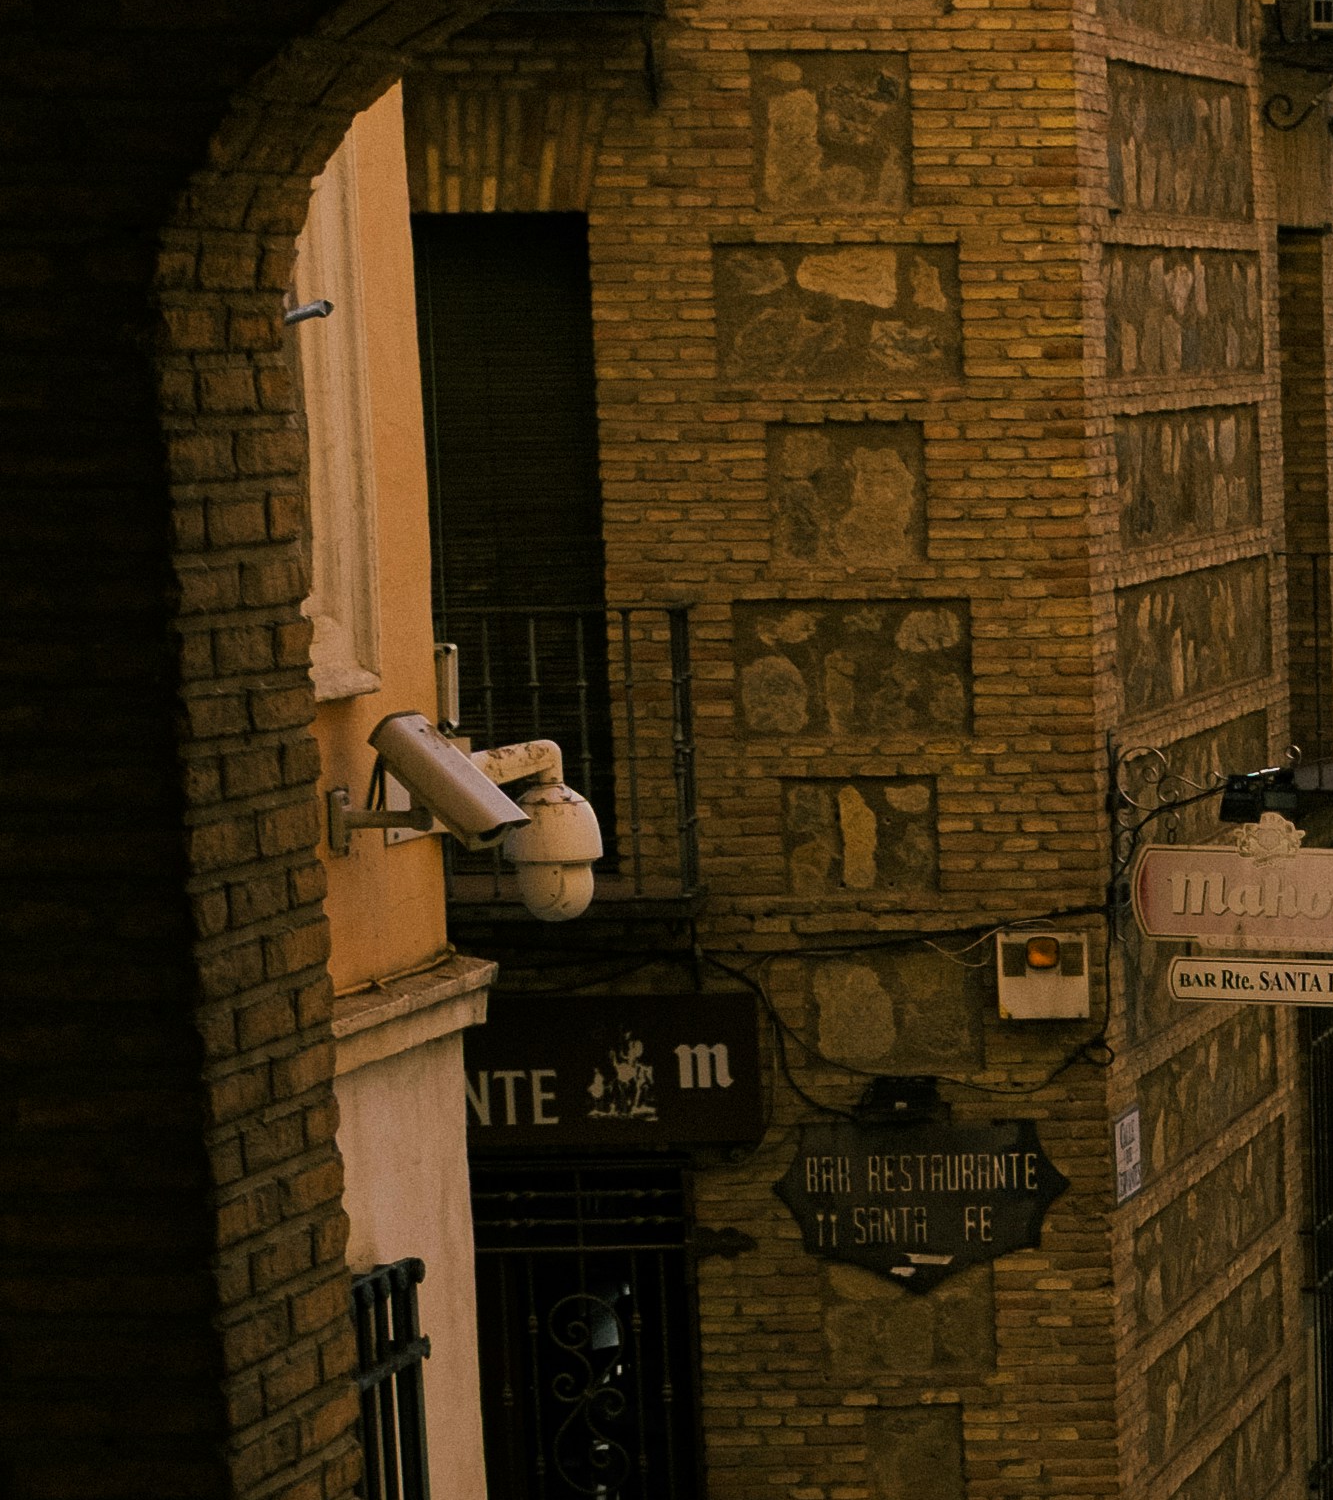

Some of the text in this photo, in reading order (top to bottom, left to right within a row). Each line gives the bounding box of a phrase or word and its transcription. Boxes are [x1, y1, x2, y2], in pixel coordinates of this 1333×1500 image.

[1206, 935, 1328, 949] CERVEZAS
[1179, 972, 1216, 988] BAR
[1221, 969, 1254, 990] Rte.
[1258, 970, 1321, 992] SANTA
[806, 1153, 1039, 1193] BAR RESTAURANTE
[853, 1206, 993, 1245] SANTA FE
